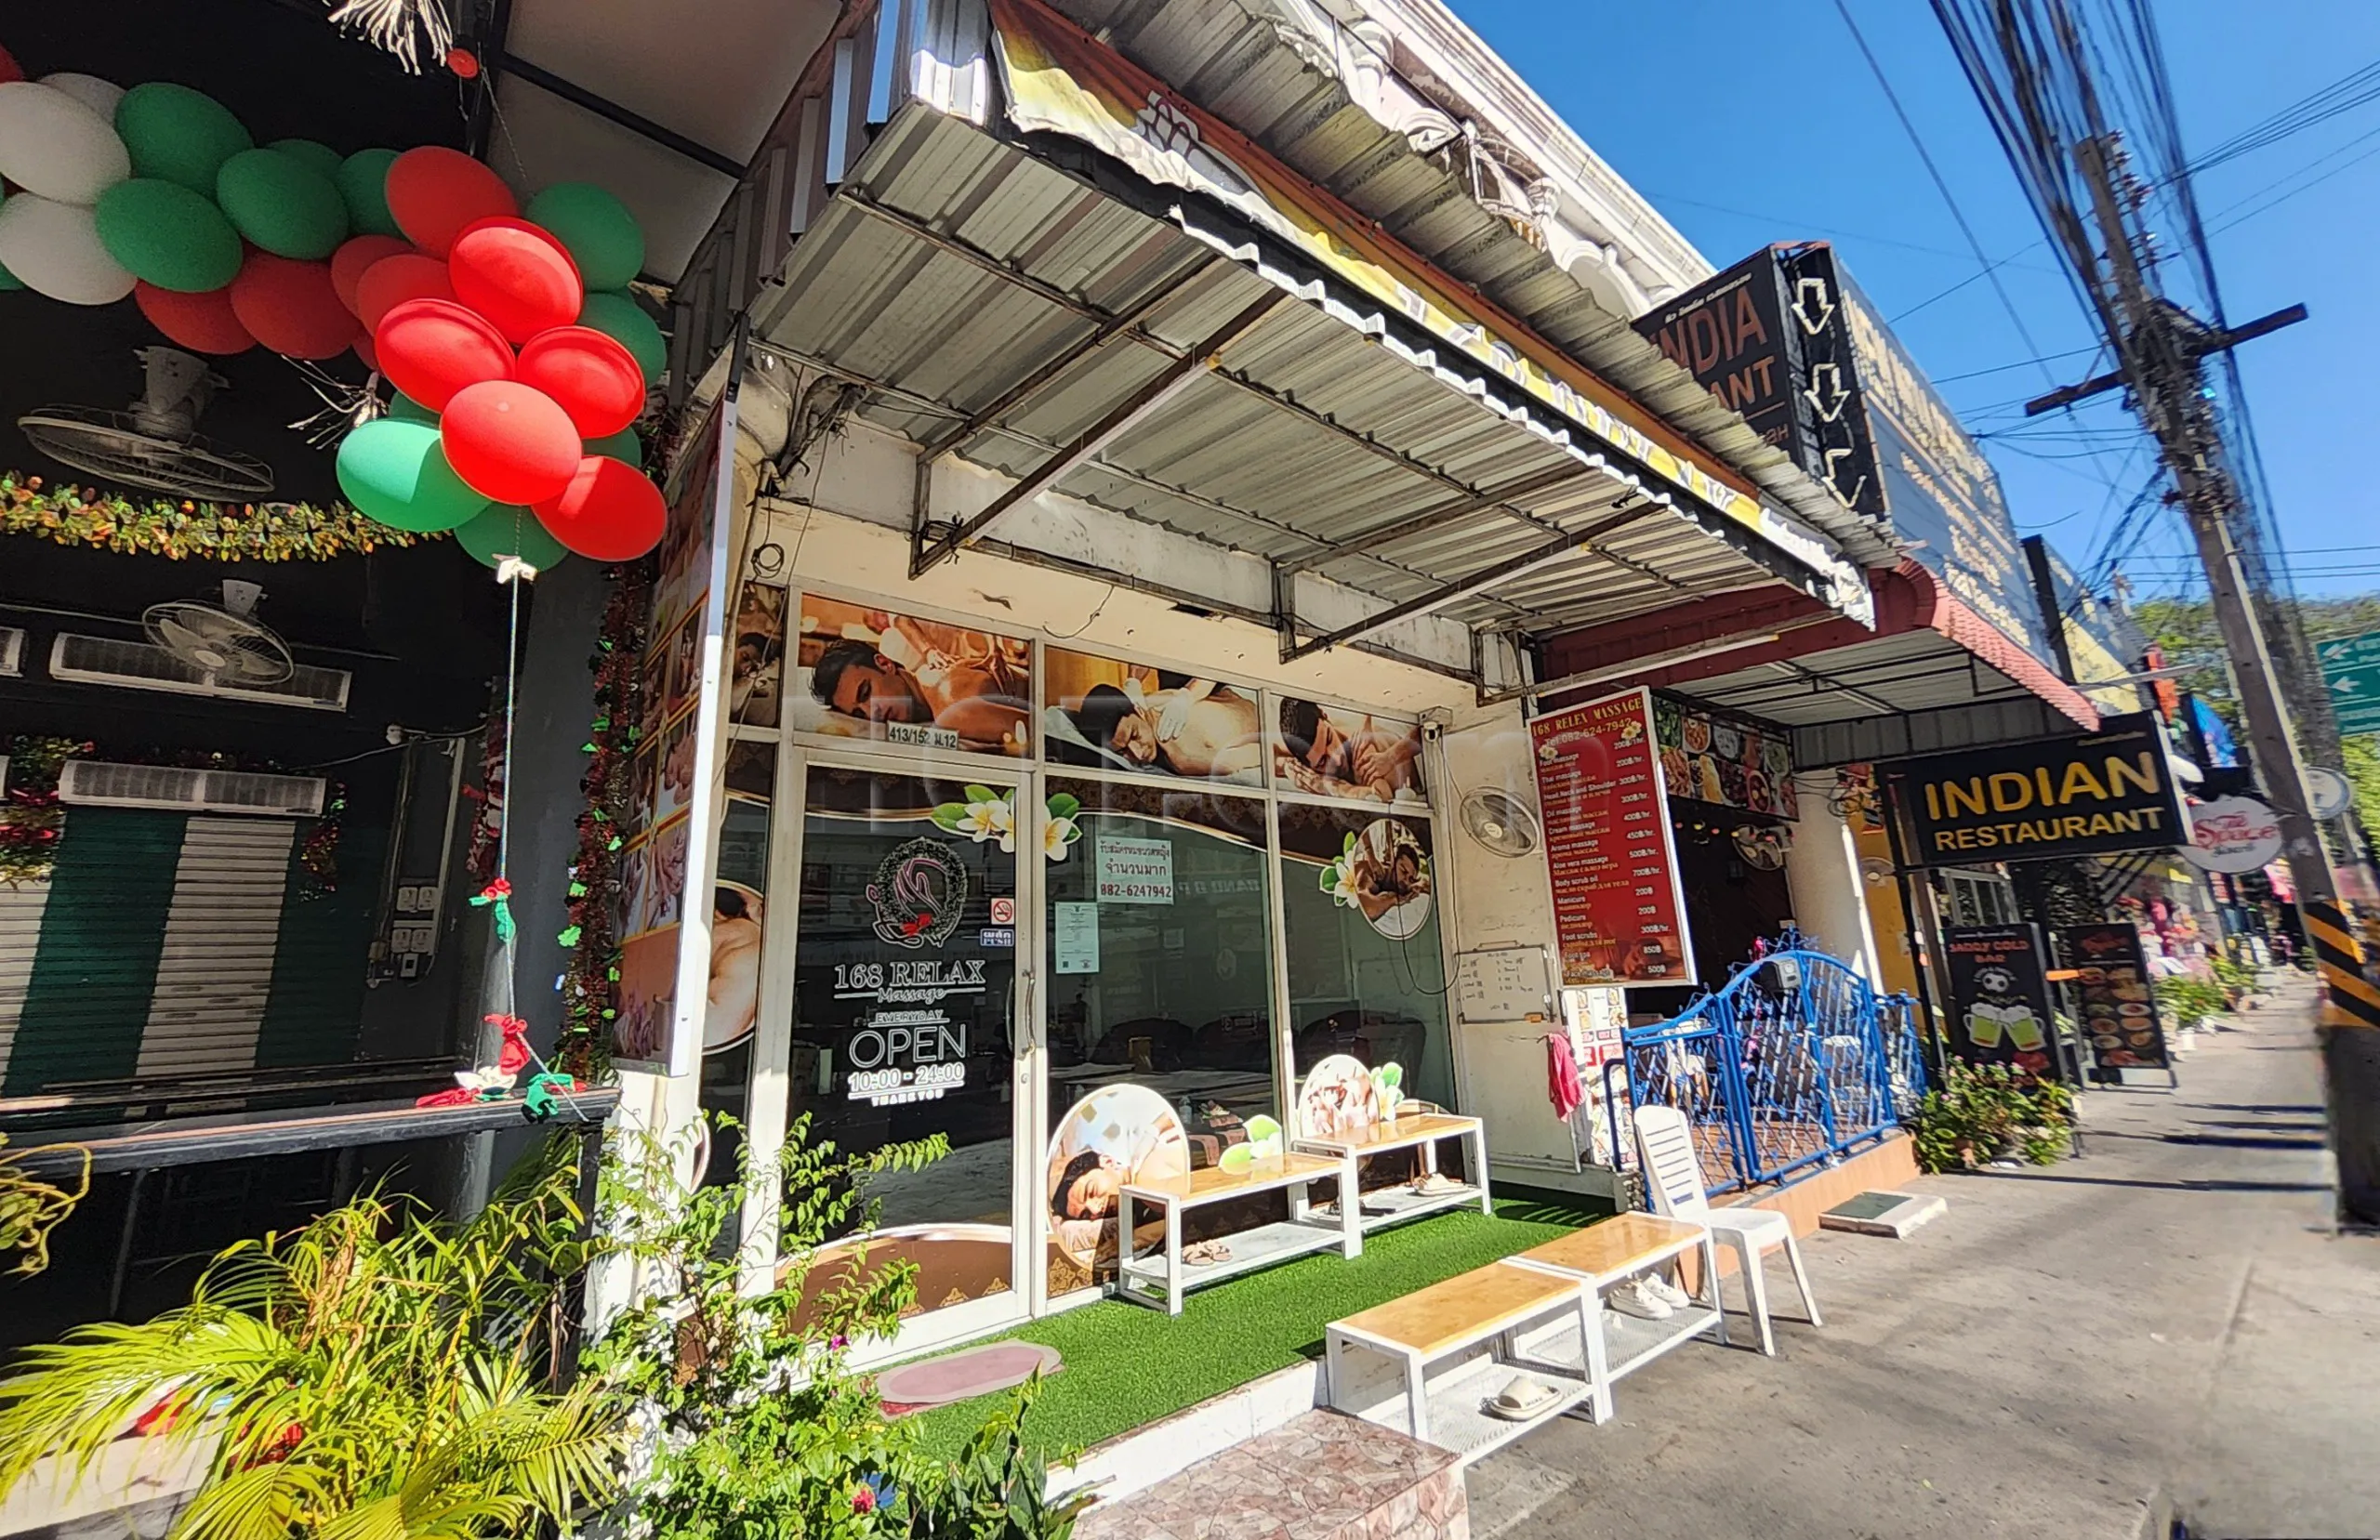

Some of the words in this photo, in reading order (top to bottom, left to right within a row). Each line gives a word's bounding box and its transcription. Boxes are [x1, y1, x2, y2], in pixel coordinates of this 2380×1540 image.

[1649, 285, 1767, 375] NDIA
[1924, 750, 2161, 821] INDIAN
[1934, 807, 2165, 851] RESTAURANT
[1105, 857, 1167, 876] จำนวนมาก
[835, 963, 884, 989] 168
[889, 959, 986, 988] RELAX
[878, 987, 946, 1005] Massage
[875, 1009, 944, 1023] EVERYDAY
[849, 1023, 967, 1069] OPEN
[848, 1068, 902, 1092] 10:00
[915, 1061, 965, 1086] 24:00
